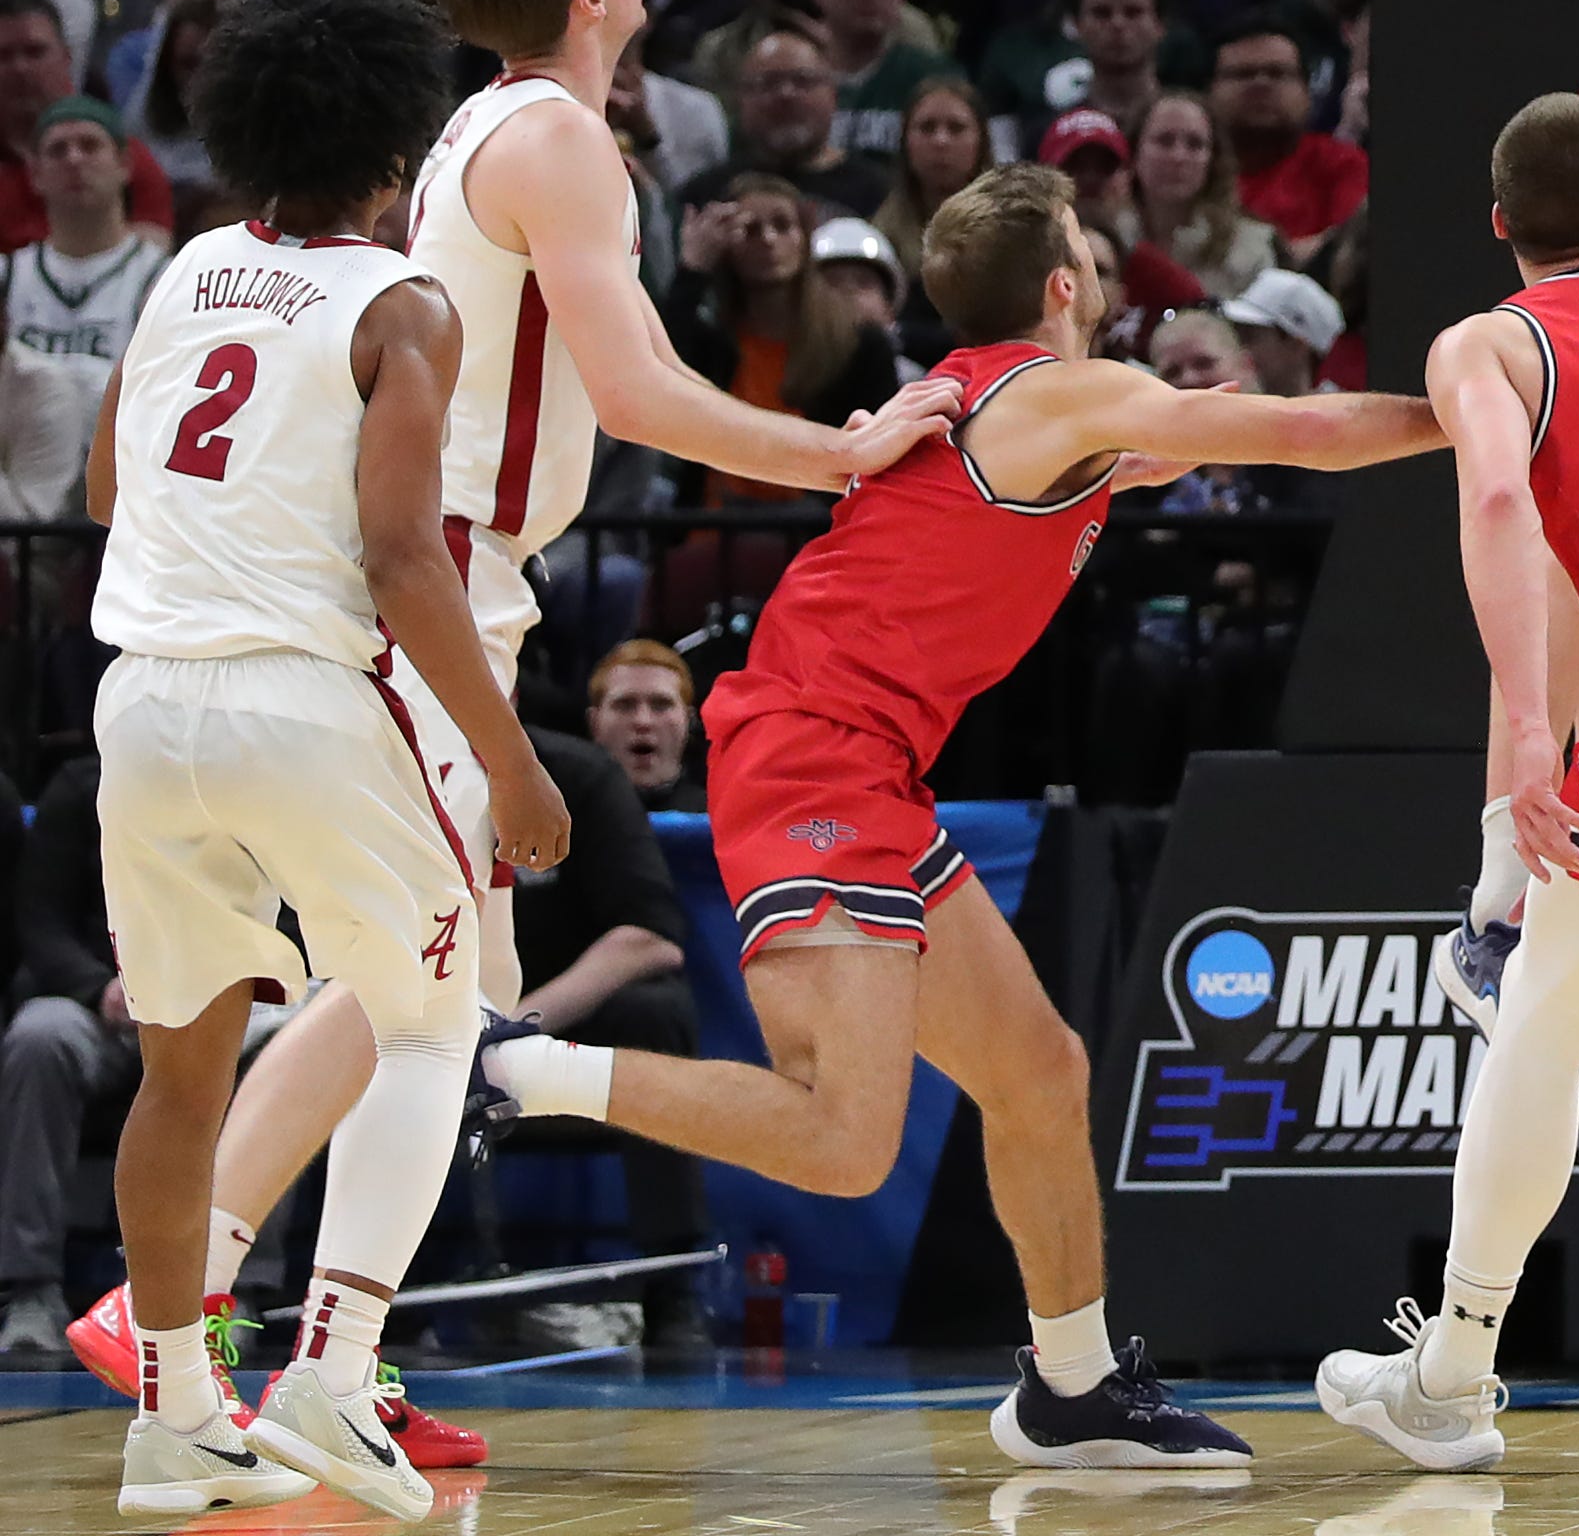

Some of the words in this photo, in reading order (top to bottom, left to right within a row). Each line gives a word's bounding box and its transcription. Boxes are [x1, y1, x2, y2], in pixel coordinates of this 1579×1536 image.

[193, 268, 327, 325] HOLLOWAY
[164, 342, 258, 482] 2
[1196, 972, 1271, 996] NCAA
